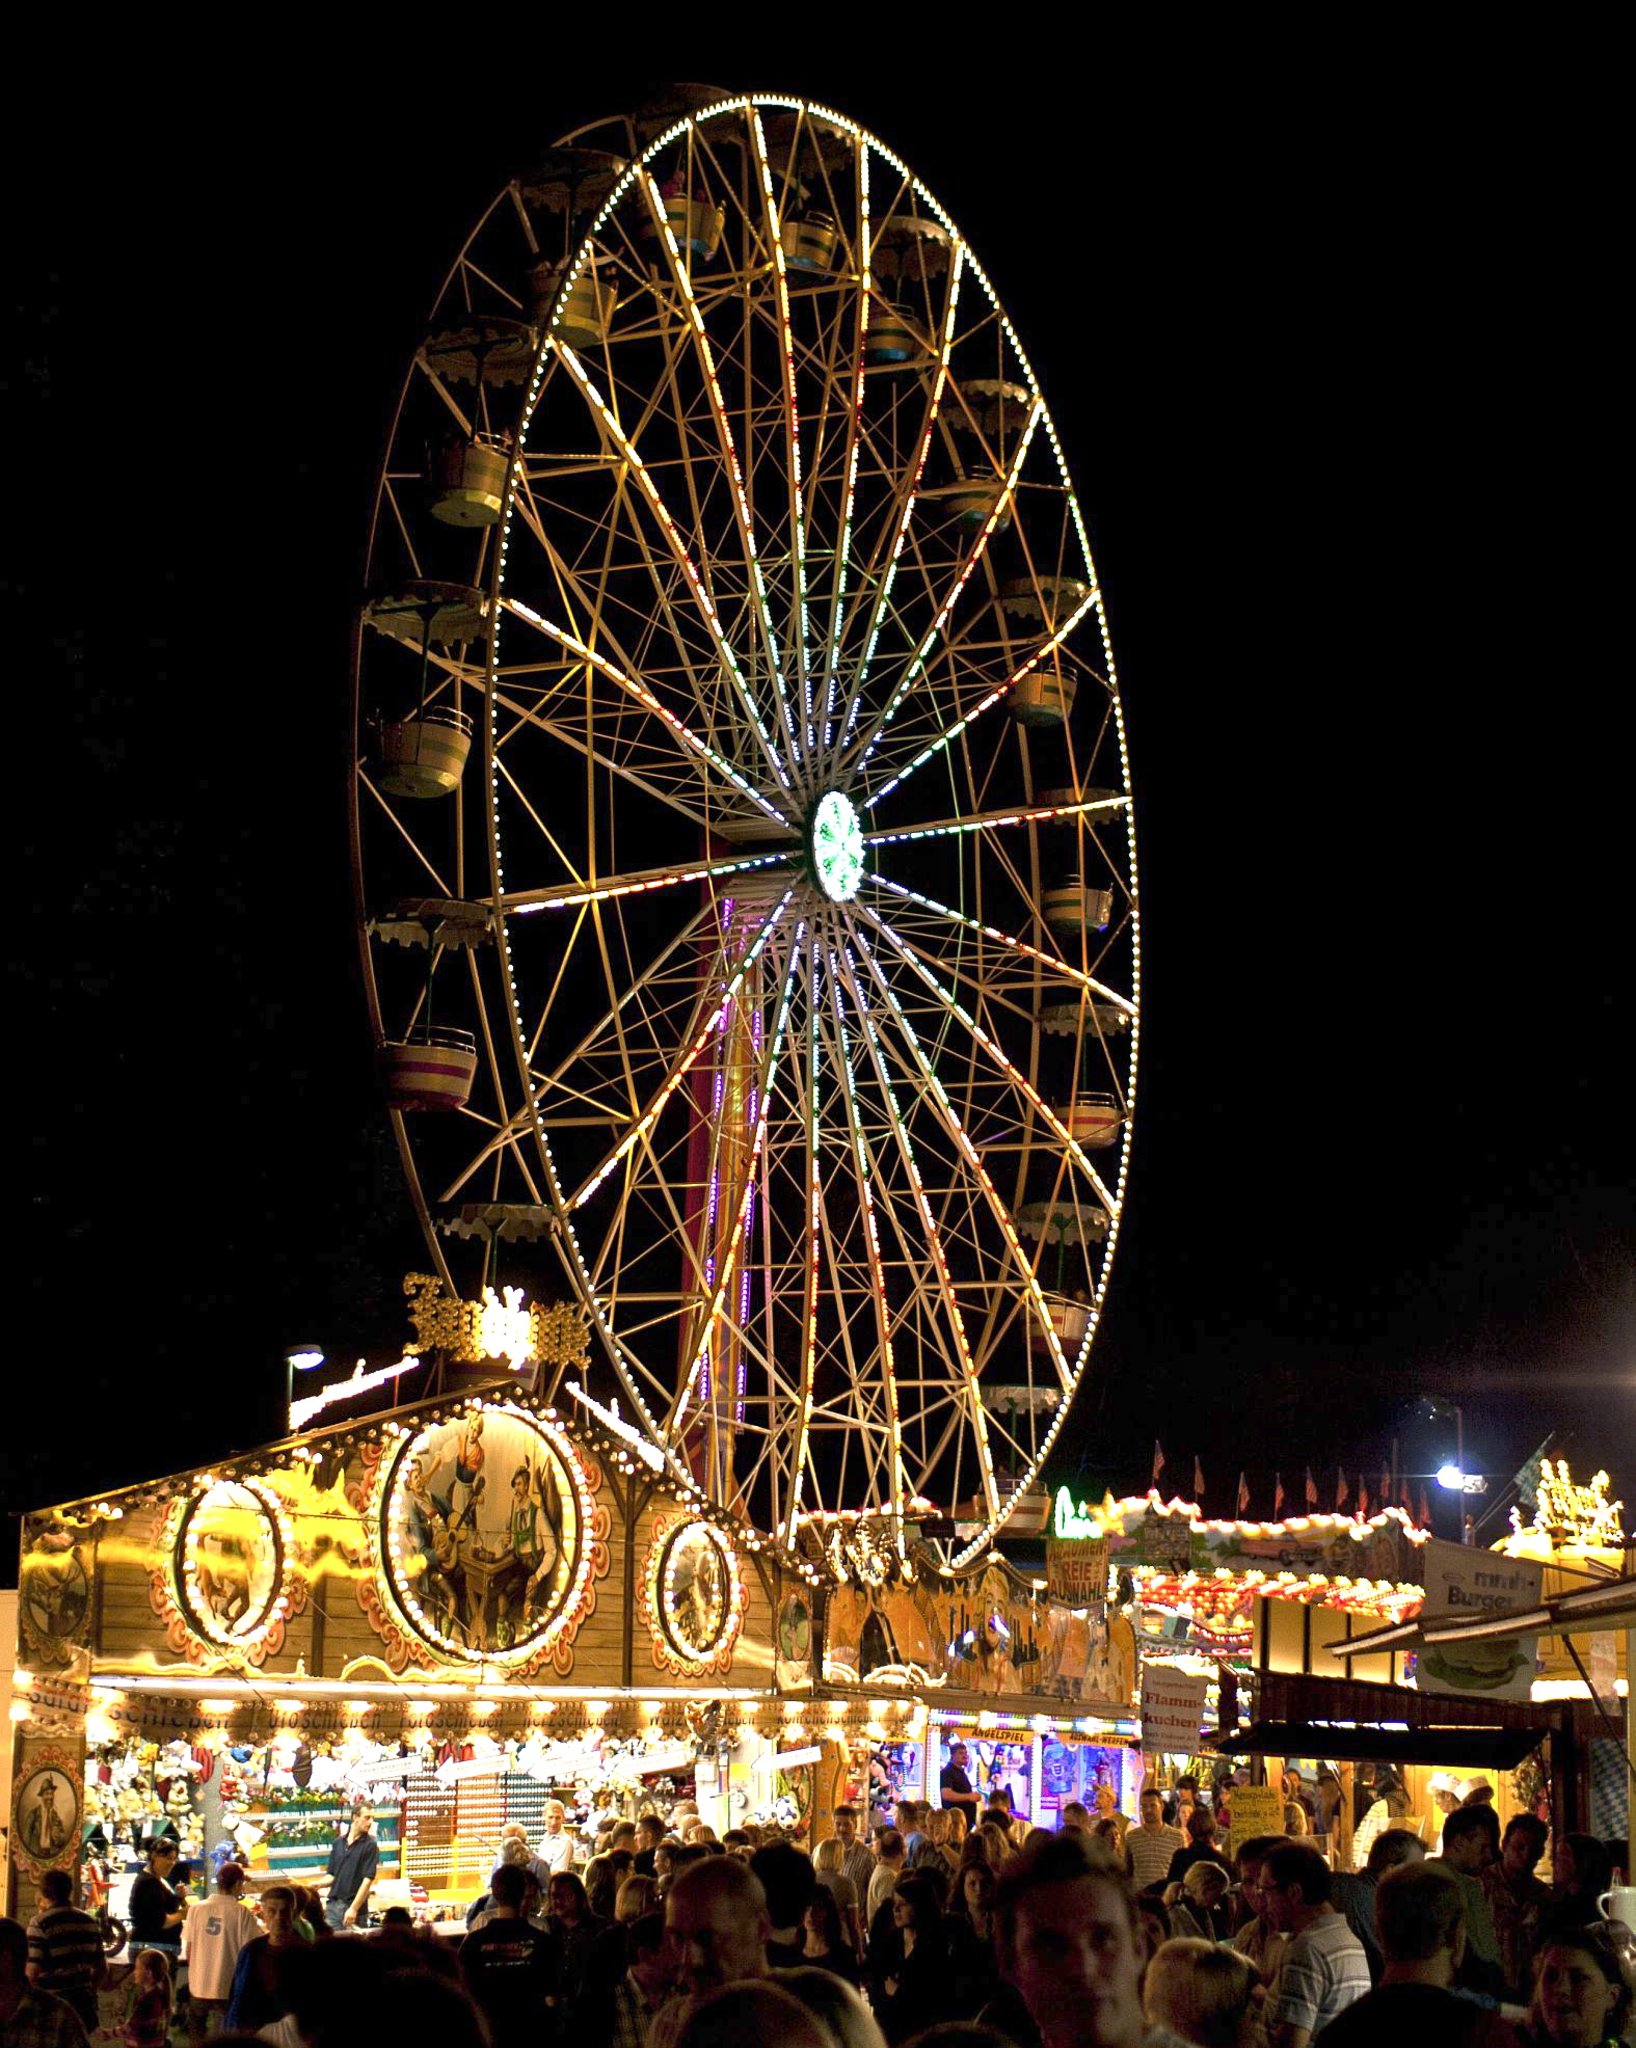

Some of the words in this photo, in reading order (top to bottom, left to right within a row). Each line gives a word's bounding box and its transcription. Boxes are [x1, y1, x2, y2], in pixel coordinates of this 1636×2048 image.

[1145, 1691, 1201, 1708] Flamm-
[1143, 1712, 1197, 1728] kuchen
[971, 1727, 1025, 1742] ANGELSPIEL
[205, 1916, 222, 1936] 5
